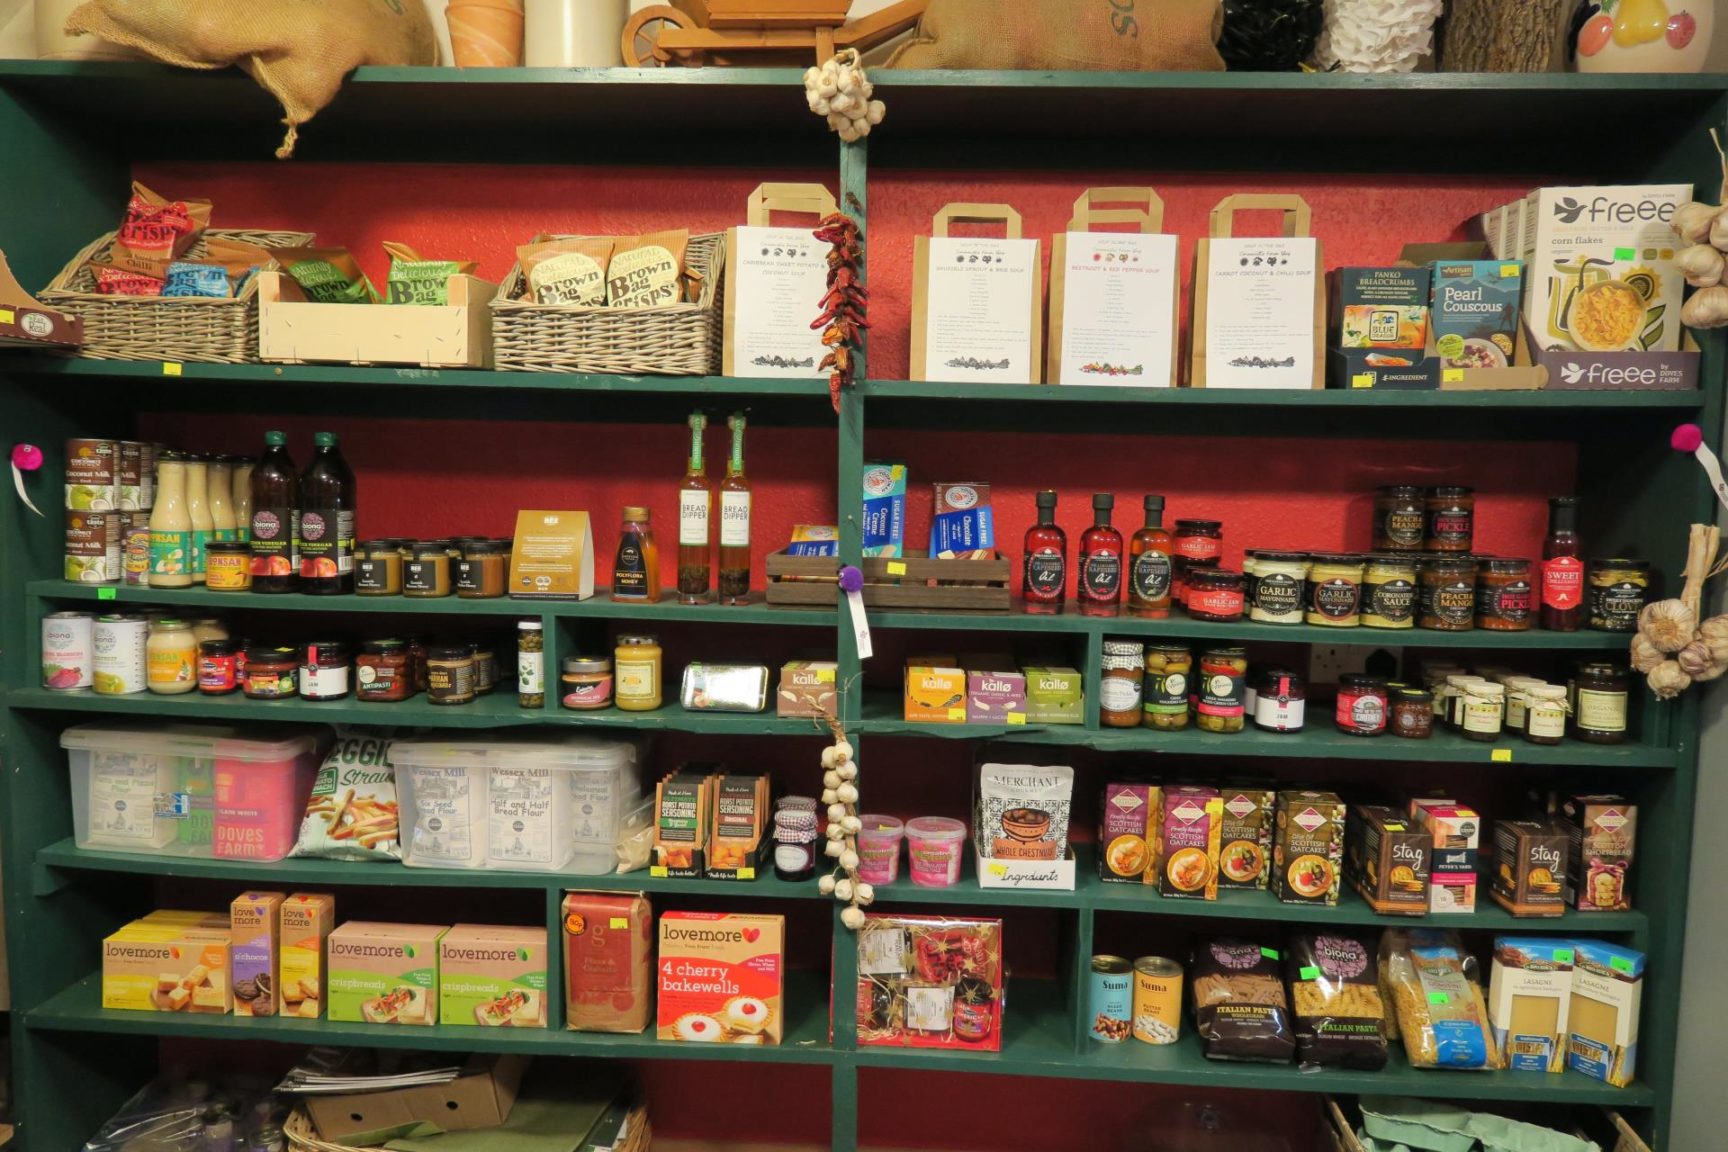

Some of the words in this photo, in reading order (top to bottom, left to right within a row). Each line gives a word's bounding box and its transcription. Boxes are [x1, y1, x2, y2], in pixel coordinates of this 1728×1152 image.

[1552, 237, 1573, 246] corn
[1575, 236, 1603, 245] flakes
[1374, 271, 1401, 282] PANKO
[1444, 287, 1483, 301] Pearl
[1443, 302, 1502, 312] Couscous
[1587, 363, 1656, 384] freee
[682, 504, 707, 512] BREAD
[682, 511, 707, 520] DIPPER
[723, 512, 748, 521] DIPPER
[253, 519, 277, 529] biona
[301, 521, 323, 530] biona
[1038, 570, 1056, 582] Oil
[1095, 573, 1112, 584] Oil
[1145, 574, 1162, 585] Oil
[1547, 571, 1579, 580] SWEET
[1260, 586, 1296, 597] GARLIC
[1318, 589, 1354, 599] GARLIC
[1383, 598, 1411, 606] SAUCE
[445, 767, 466, 778] Mill
[491, 767, 525, 778] Wessex
[528, 768, 550, 778] Mill
[995, 776, 1061, 787] MERCHANT
[434, 800, 453, 808] Seed
[491, 800, 508, 810] Half
[510, 800, 527, 810] and
[529, 801, 550, 811] Half
[495, 808, 519, 816] Bread
[521, 809, 545, 817] Flour
[662, 809, 697, 818] SEASONING
[720, 805, 754, 815] SEASONING
[1108, 827, 1143, 835] OATCAKES
[1222, 832, 1257, 840] OATCAKES
[1169, 833, 1204, 841] SCOTTISH
[1169, 840, 1205, 848] OATCAKES
[1291, 840, 1325, 848] SCOTTISH
[996, 849, 1018, 858] WHOLE
[1019, 849, 1053, 858] CHESTNUTS
[1393, 843, 1424, 871] stag
[1531, 845, 1560, 873] stag
[234, 907, 255, 917] love
[284, 908, 305, 918] love
[233, 916, 261, 925] more
[283, 917, 311, 927] more
[664, 925, 743, 942] lovemore
[106, 943, 170, 958] lovemore
[331, 940, 404, 958] lovemore
[443, 943, 517, 961] lovemore
[1323, 945, 1357, 960] biona
[662, 962, 673, 975] 4
[677, 960, 728, 982] cherry
[331, 979, 387, 989] crispbreads
[442, 982, 500, 992] crispbreads
[1103, 980, 1129, 990] Suma
[1141, 979, 1168, 992] Suma
[663, 979, 740, 1000] bakewells
[1217, 1006, 1250, 1014] ITALIAN
[1355, 1025, 1377, 1033] PASTA
